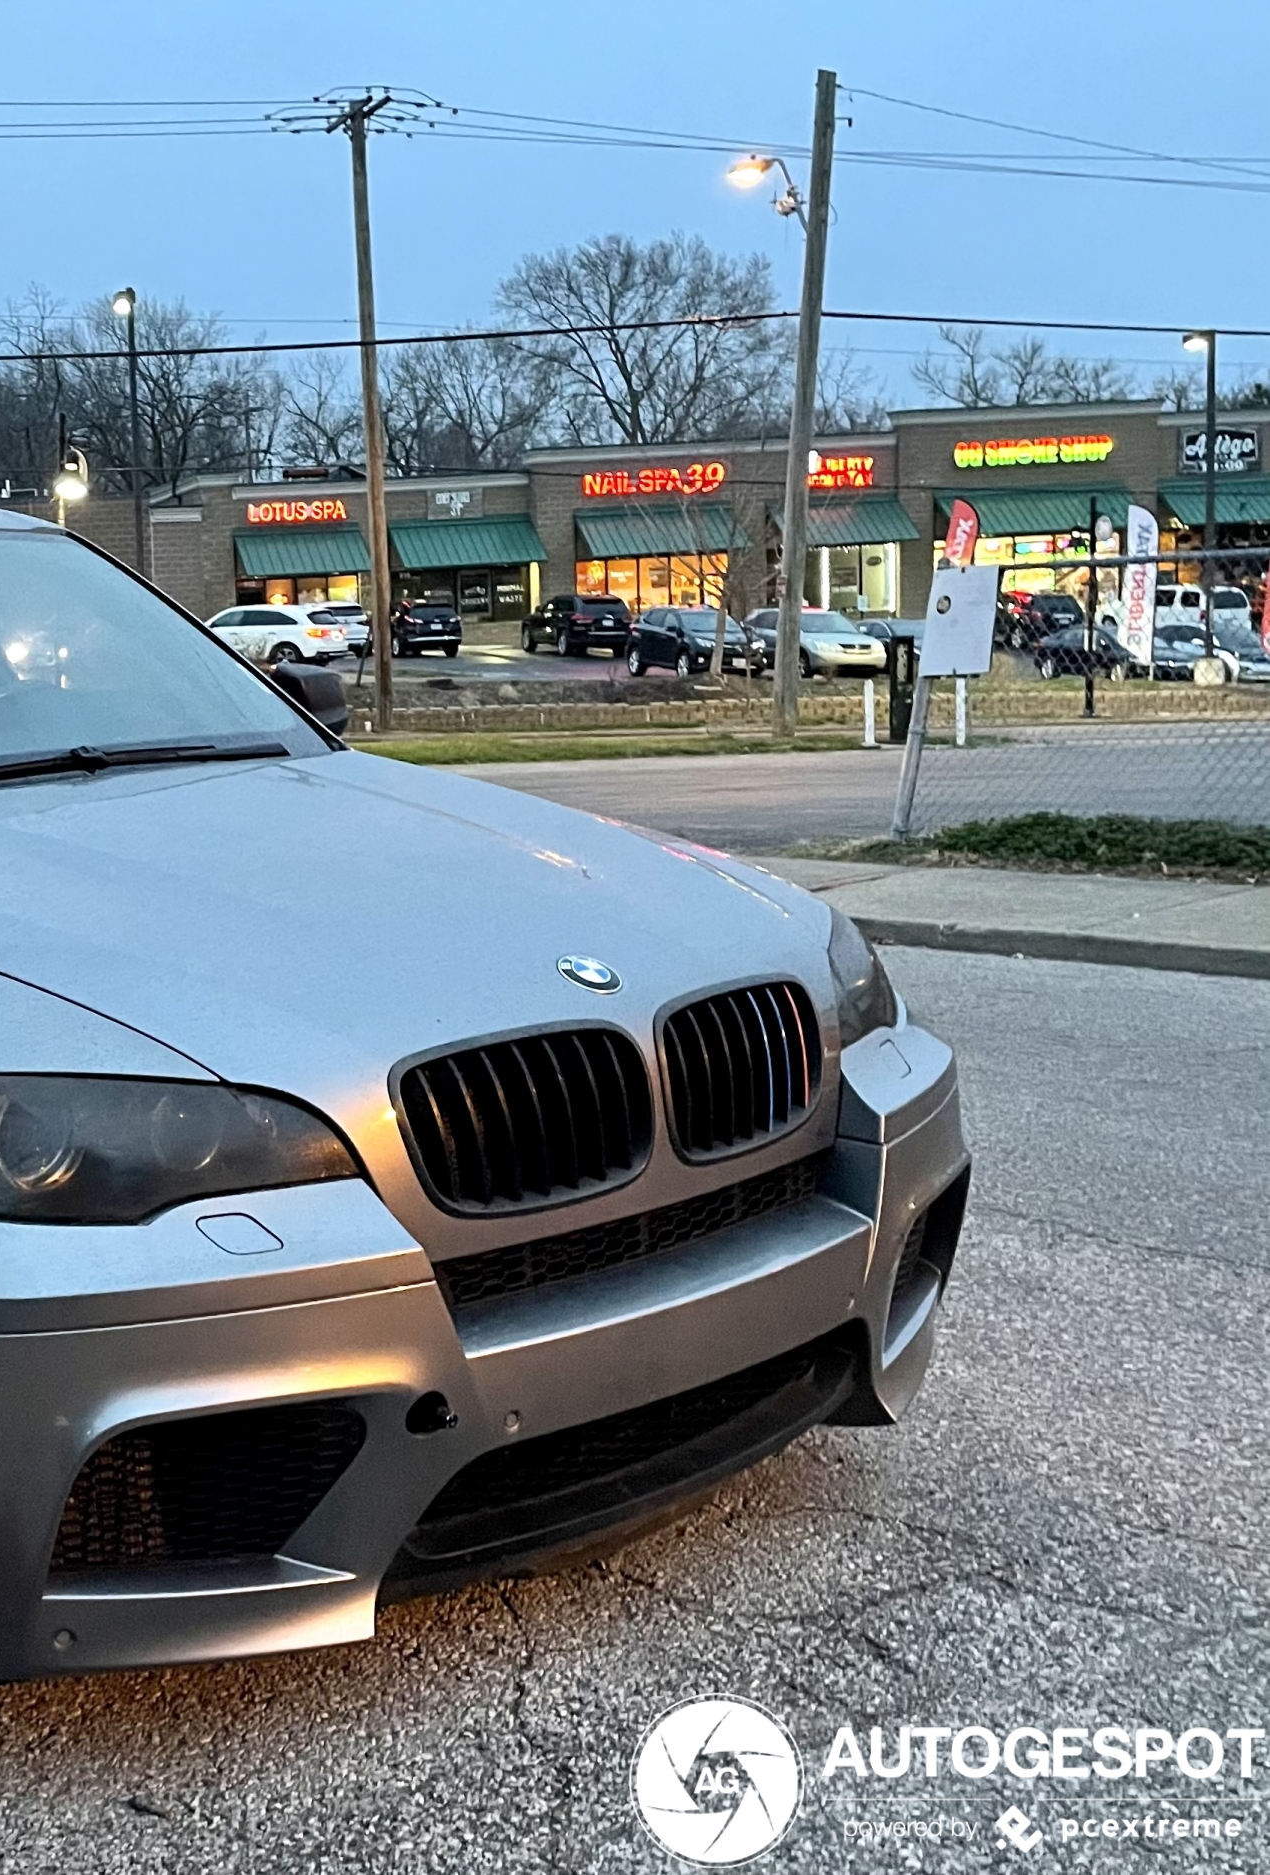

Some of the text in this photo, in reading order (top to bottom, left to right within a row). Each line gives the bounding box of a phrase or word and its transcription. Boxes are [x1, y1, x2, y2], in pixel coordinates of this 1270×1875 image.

[985, 438, 1059, 466] SMOKE
[1059, 434, 1113, 463] SHOP
[816, 456, 874, 472] LIBERTY
[583, 462, 726, 496] NAIL SPA 39
[247, 500, 347, 522] LOTUS SPA
